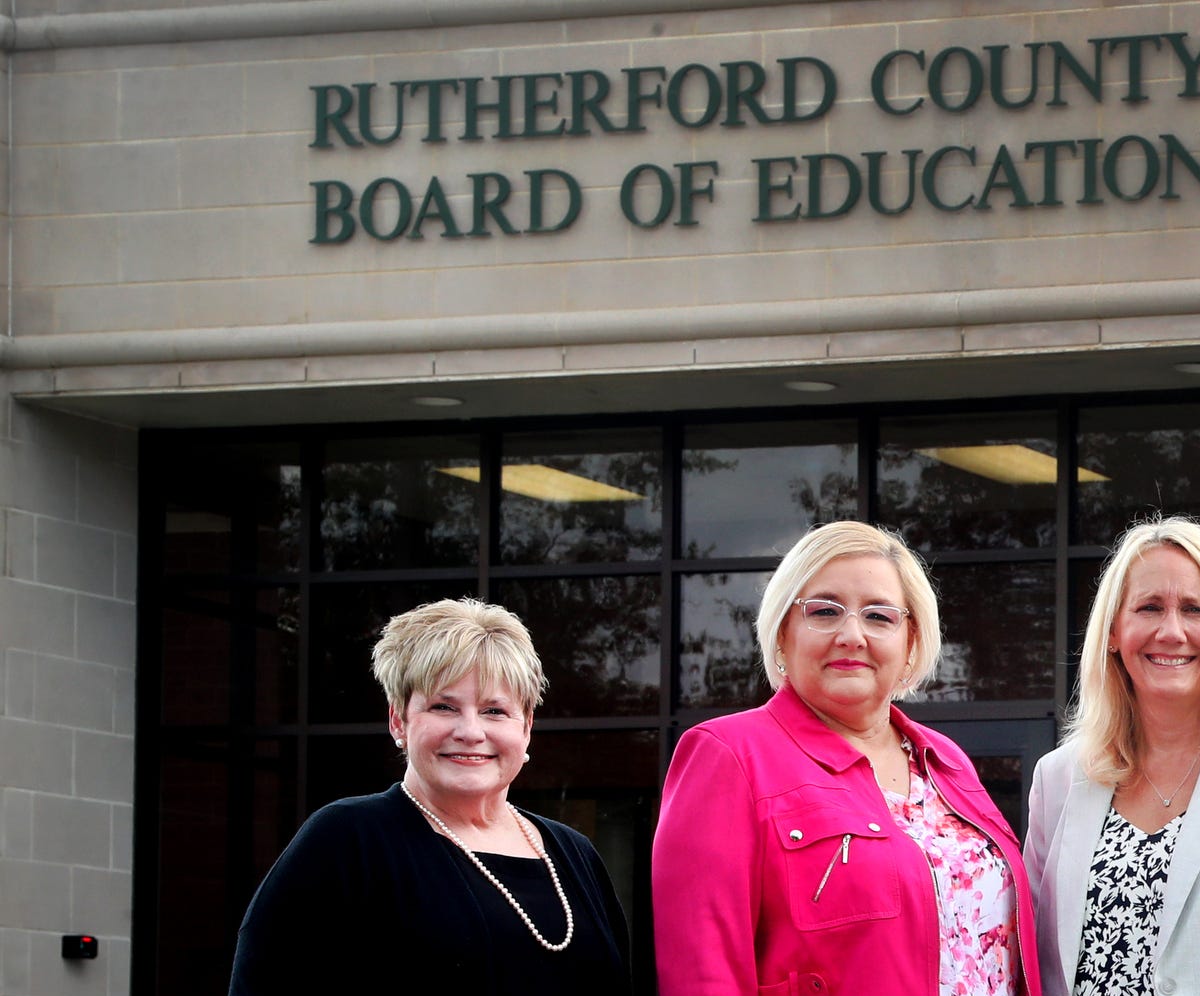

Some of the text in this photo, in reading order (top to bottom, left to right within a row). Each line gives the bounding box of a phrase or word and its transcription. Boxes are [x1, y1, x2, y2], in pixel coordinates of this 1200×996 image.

[308, 57, 838, 149] RUTHERFORD
[308, 168, 584, 246] BOARD
[619, 160, 720, 230] OF
